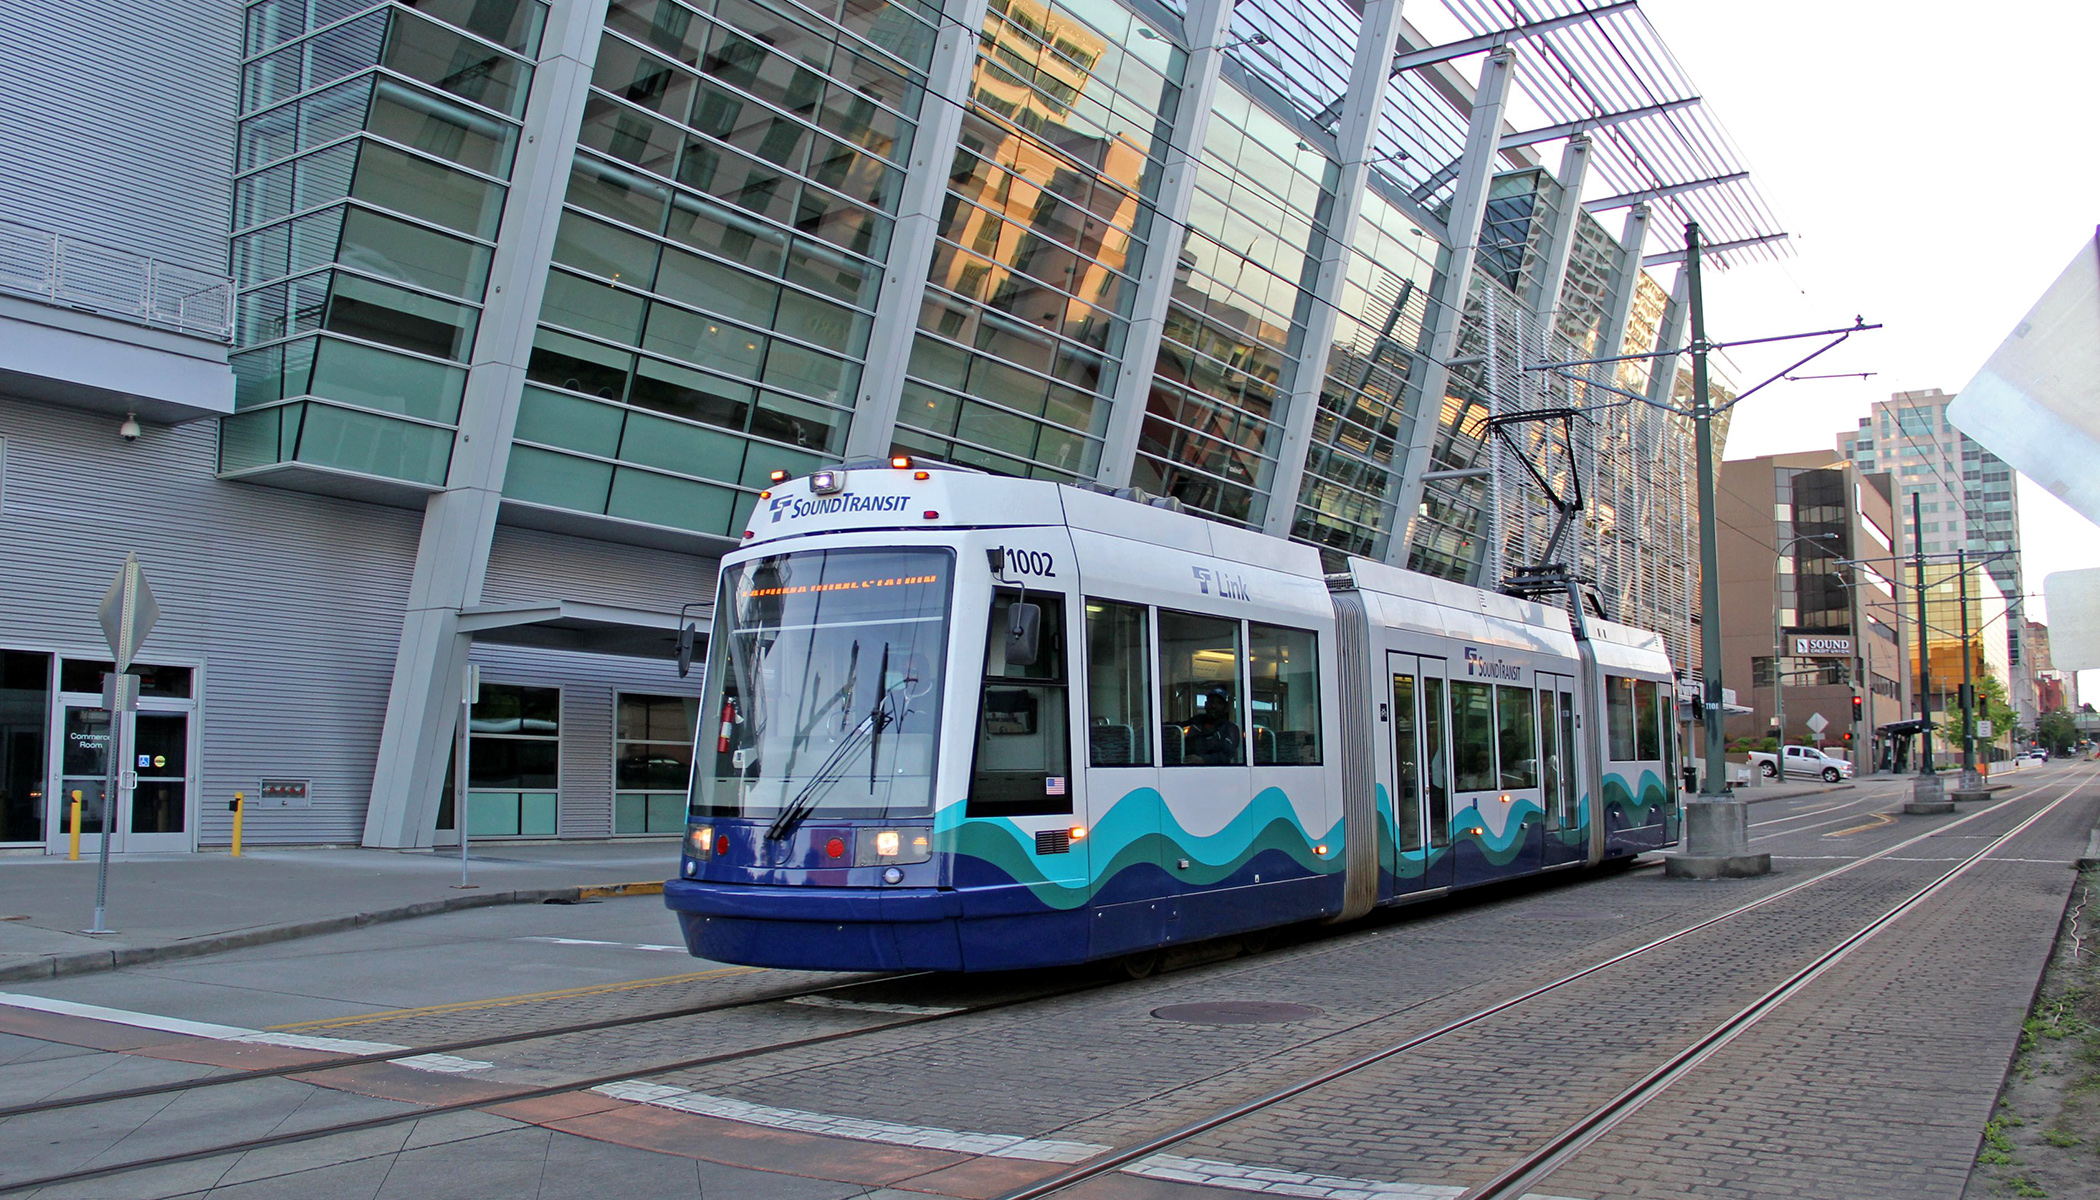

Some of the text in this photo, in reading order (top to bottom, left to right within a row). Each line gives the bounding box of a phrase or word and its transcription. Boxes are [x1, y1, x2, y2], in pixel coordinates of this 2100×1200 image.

[1006, 549, 1056, 578] 1002
[1217, 570, 1251, 602] Link
[1810, 639, 1849, 649] SOUND
[79, 741, 103, 749] Room
